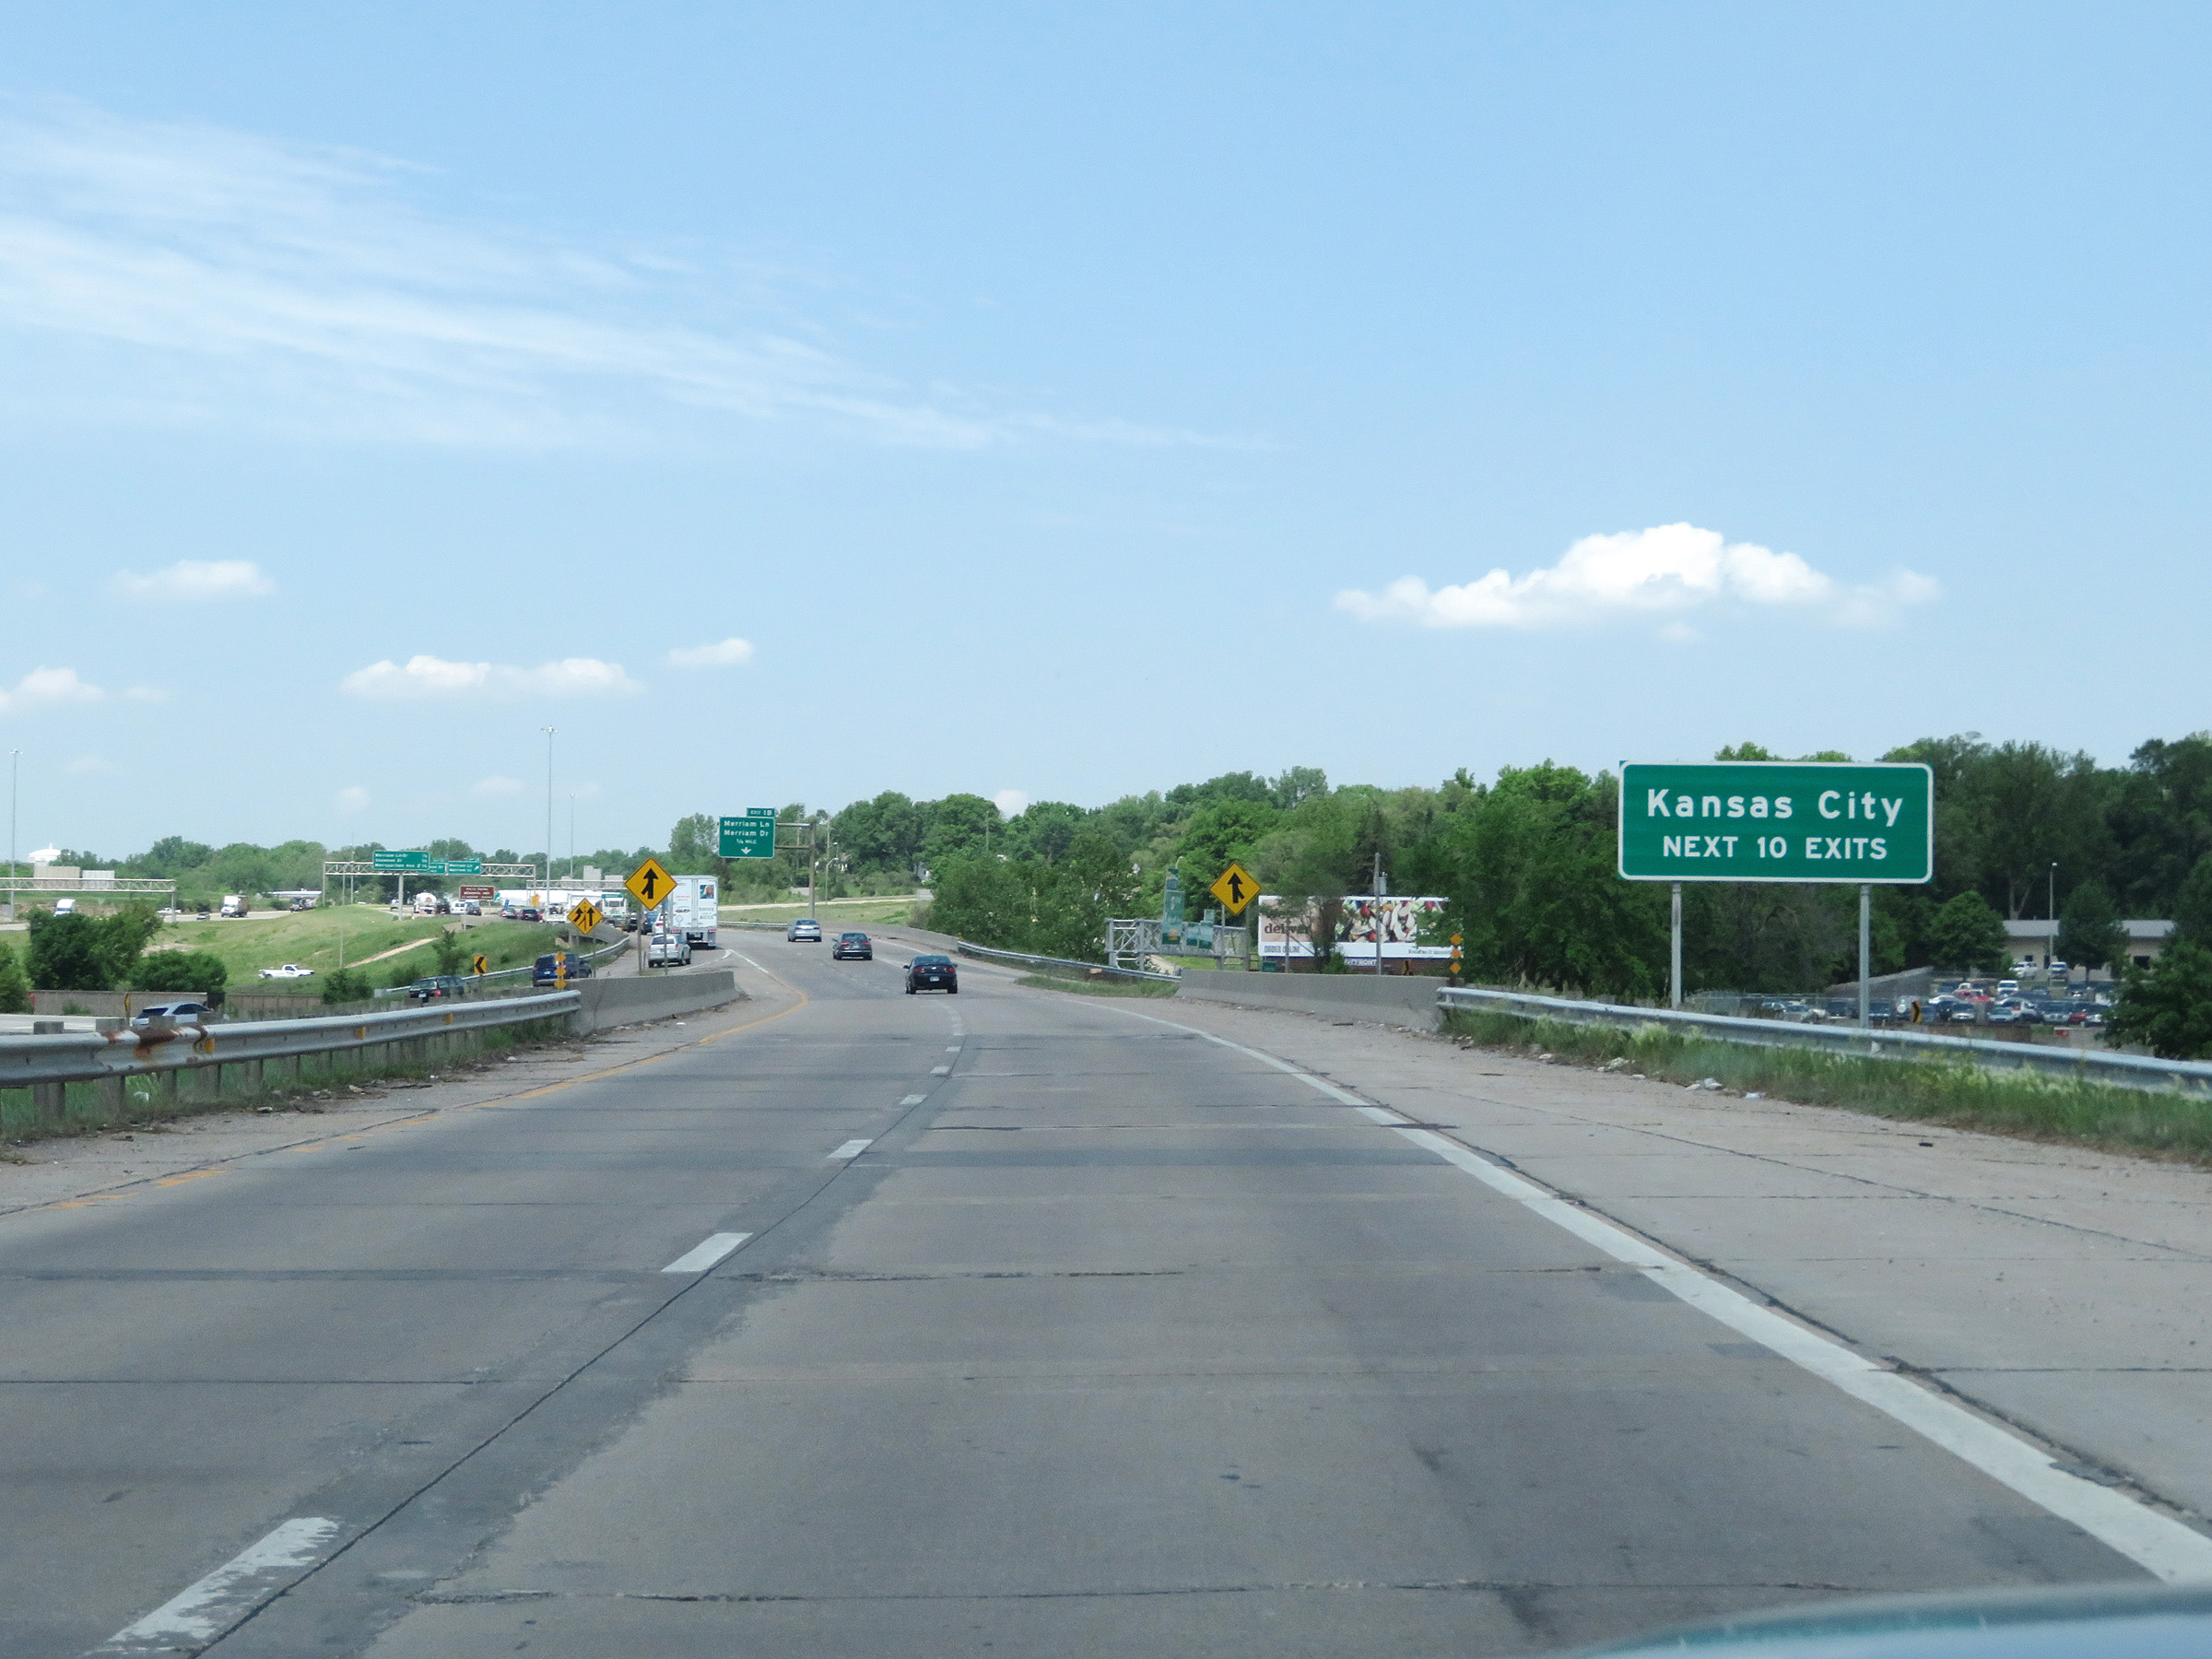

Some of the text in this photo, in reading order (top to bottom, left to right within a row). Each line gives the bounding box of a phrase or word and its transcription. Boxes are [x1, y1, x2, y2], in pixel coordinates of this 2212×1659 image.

[1647, 788, 1903, 827] Kansas City
[1663, 835, 1888, 860] NEXT 10 EXITS
